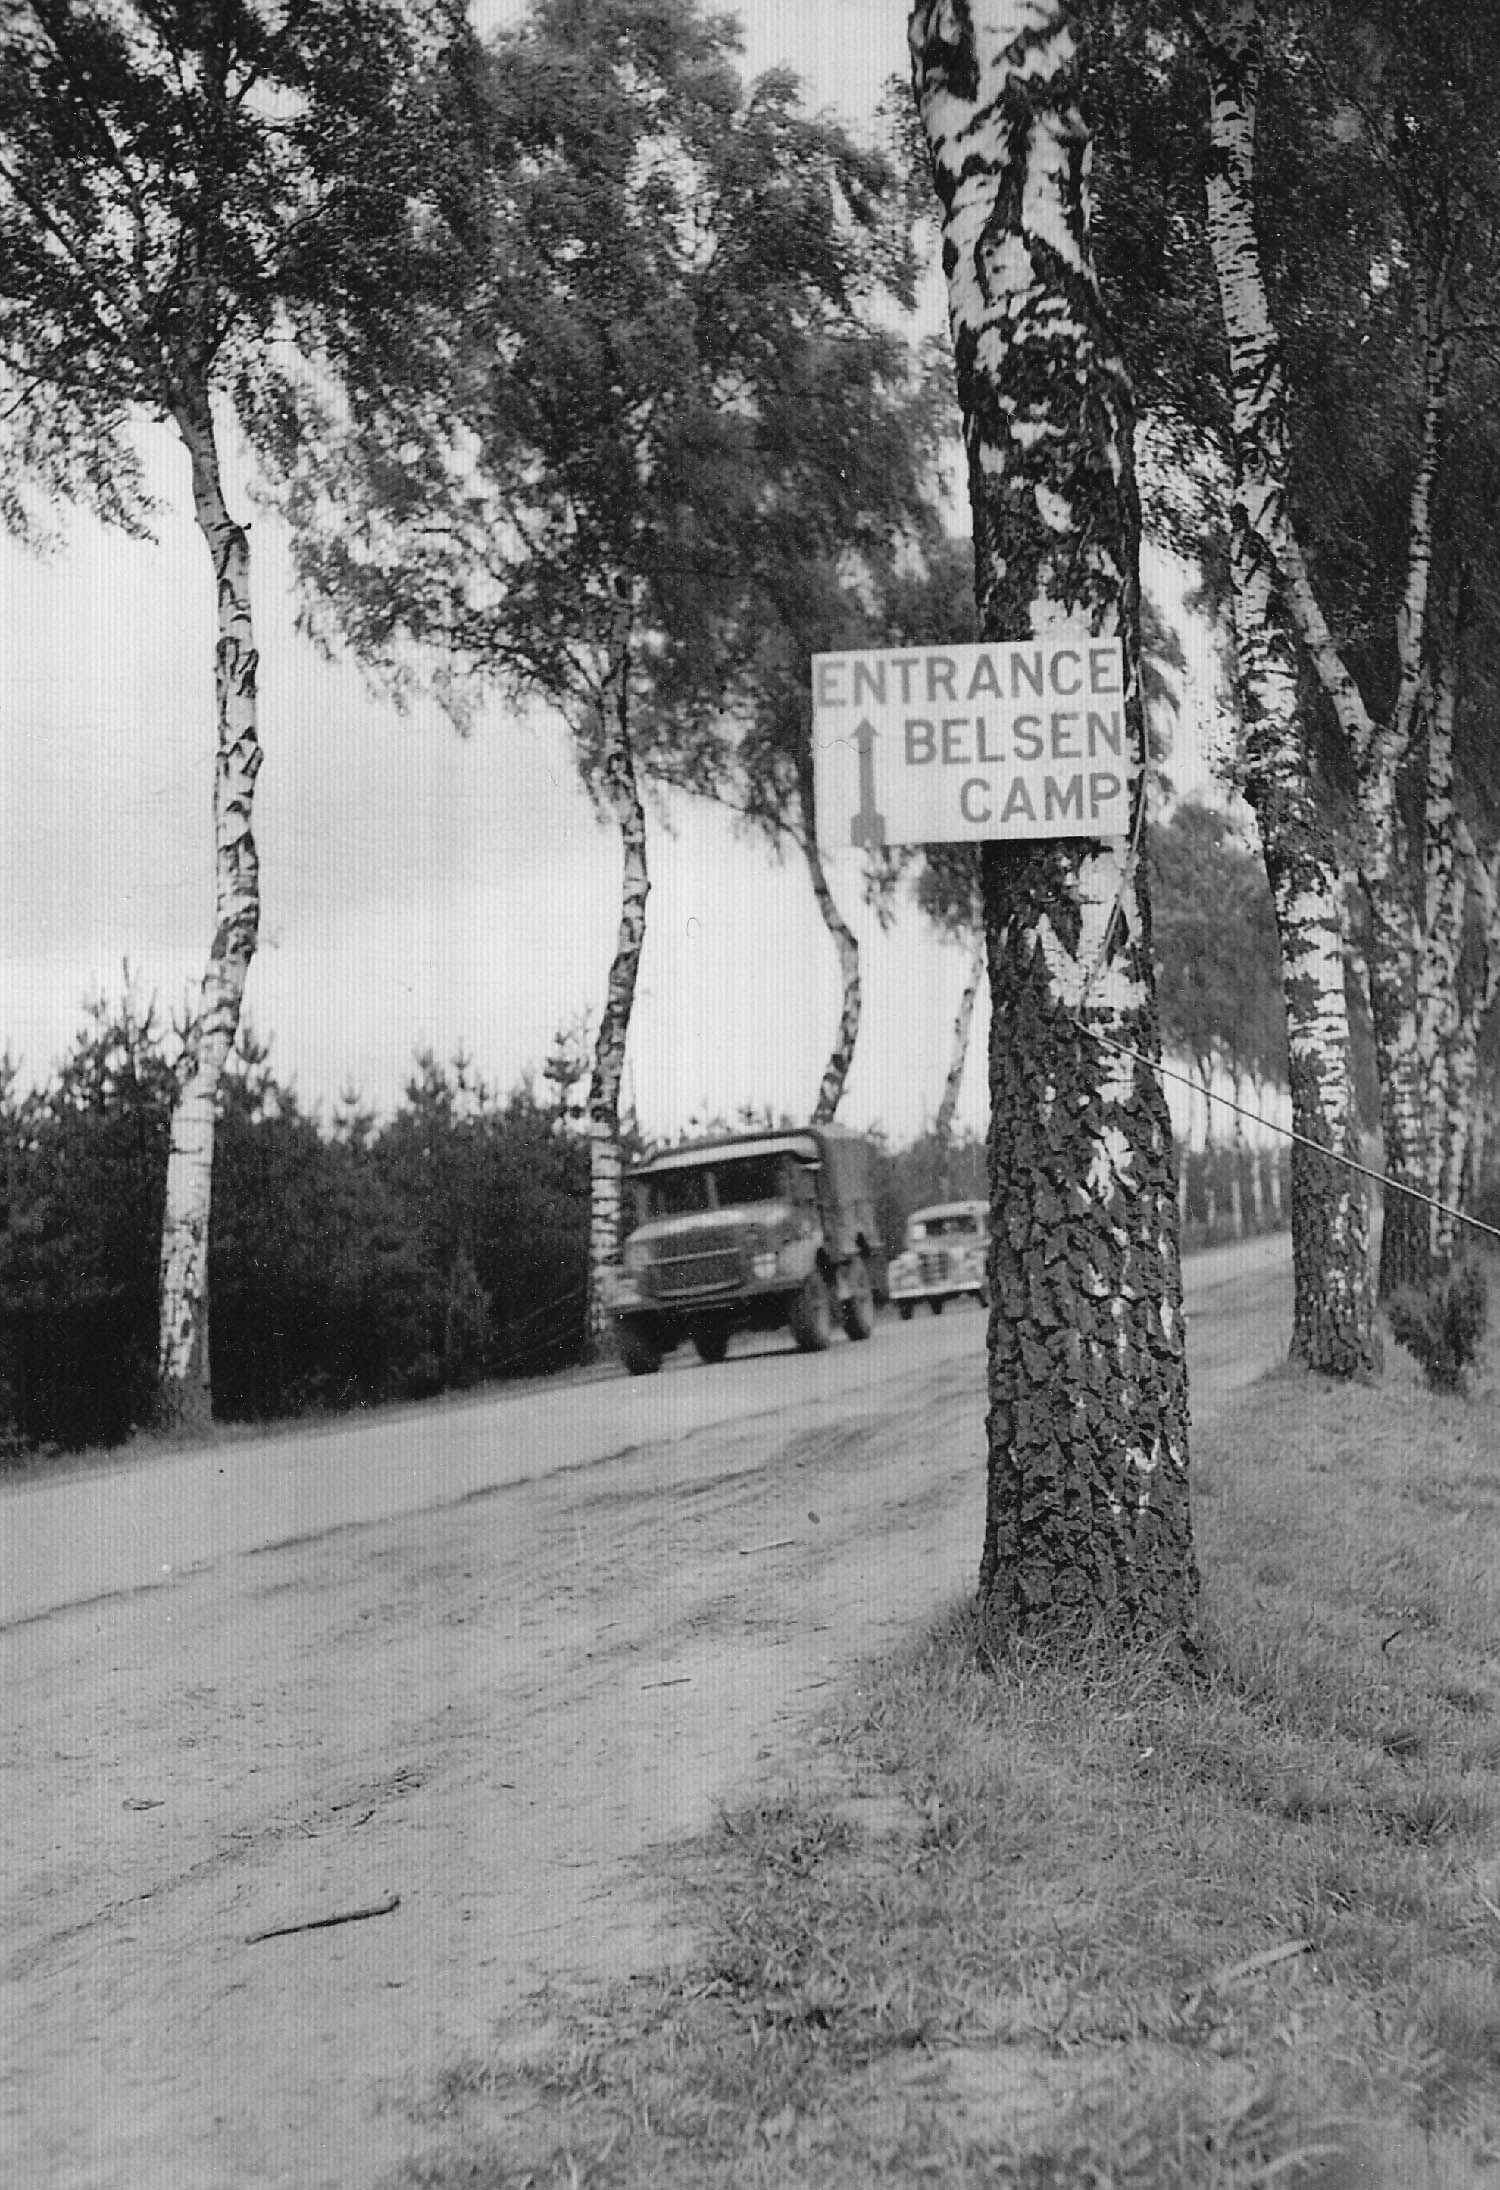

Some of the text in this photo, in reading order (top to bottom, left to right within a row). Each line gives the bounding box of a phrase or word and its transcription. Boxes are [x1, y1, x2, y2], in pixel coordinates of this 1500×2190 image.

[816, 648, 1121, 707] ENTRANCE
[904, 711, 1121, 766] BELSEN
[960, 772, 1121, 823] CAMP
